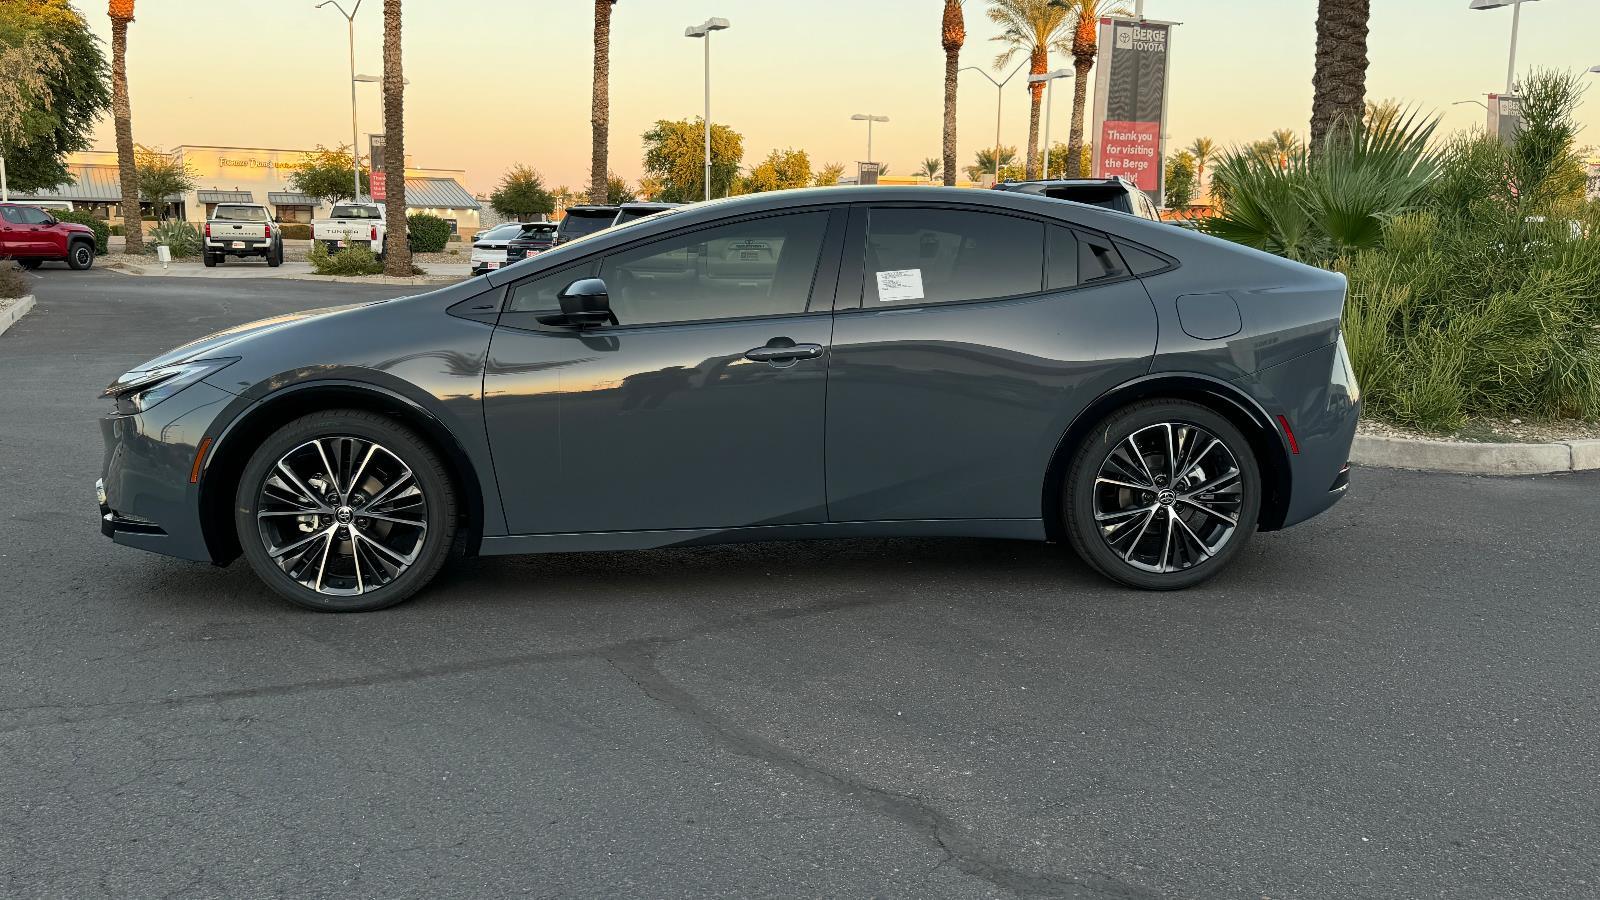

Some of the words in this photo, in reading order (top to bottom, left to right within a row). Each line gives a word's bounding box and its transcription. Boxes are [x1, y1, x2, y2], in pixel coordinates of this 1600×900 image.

[1133, 26, 1166, 42] BERGE
[1132, 42, 1165, 52] TOYOTA
[1108, 130, 1137, 140] Thank
[1138, 133, 1152, 143] you
[1106, 143, 1121, 154] for
[1122, 144, 1154, 158] visiting
[1105, 158, 1121, 168] the
[1122, 159, 1149, 171] Berge
[1104, 172, 1138, 183] Fily!
